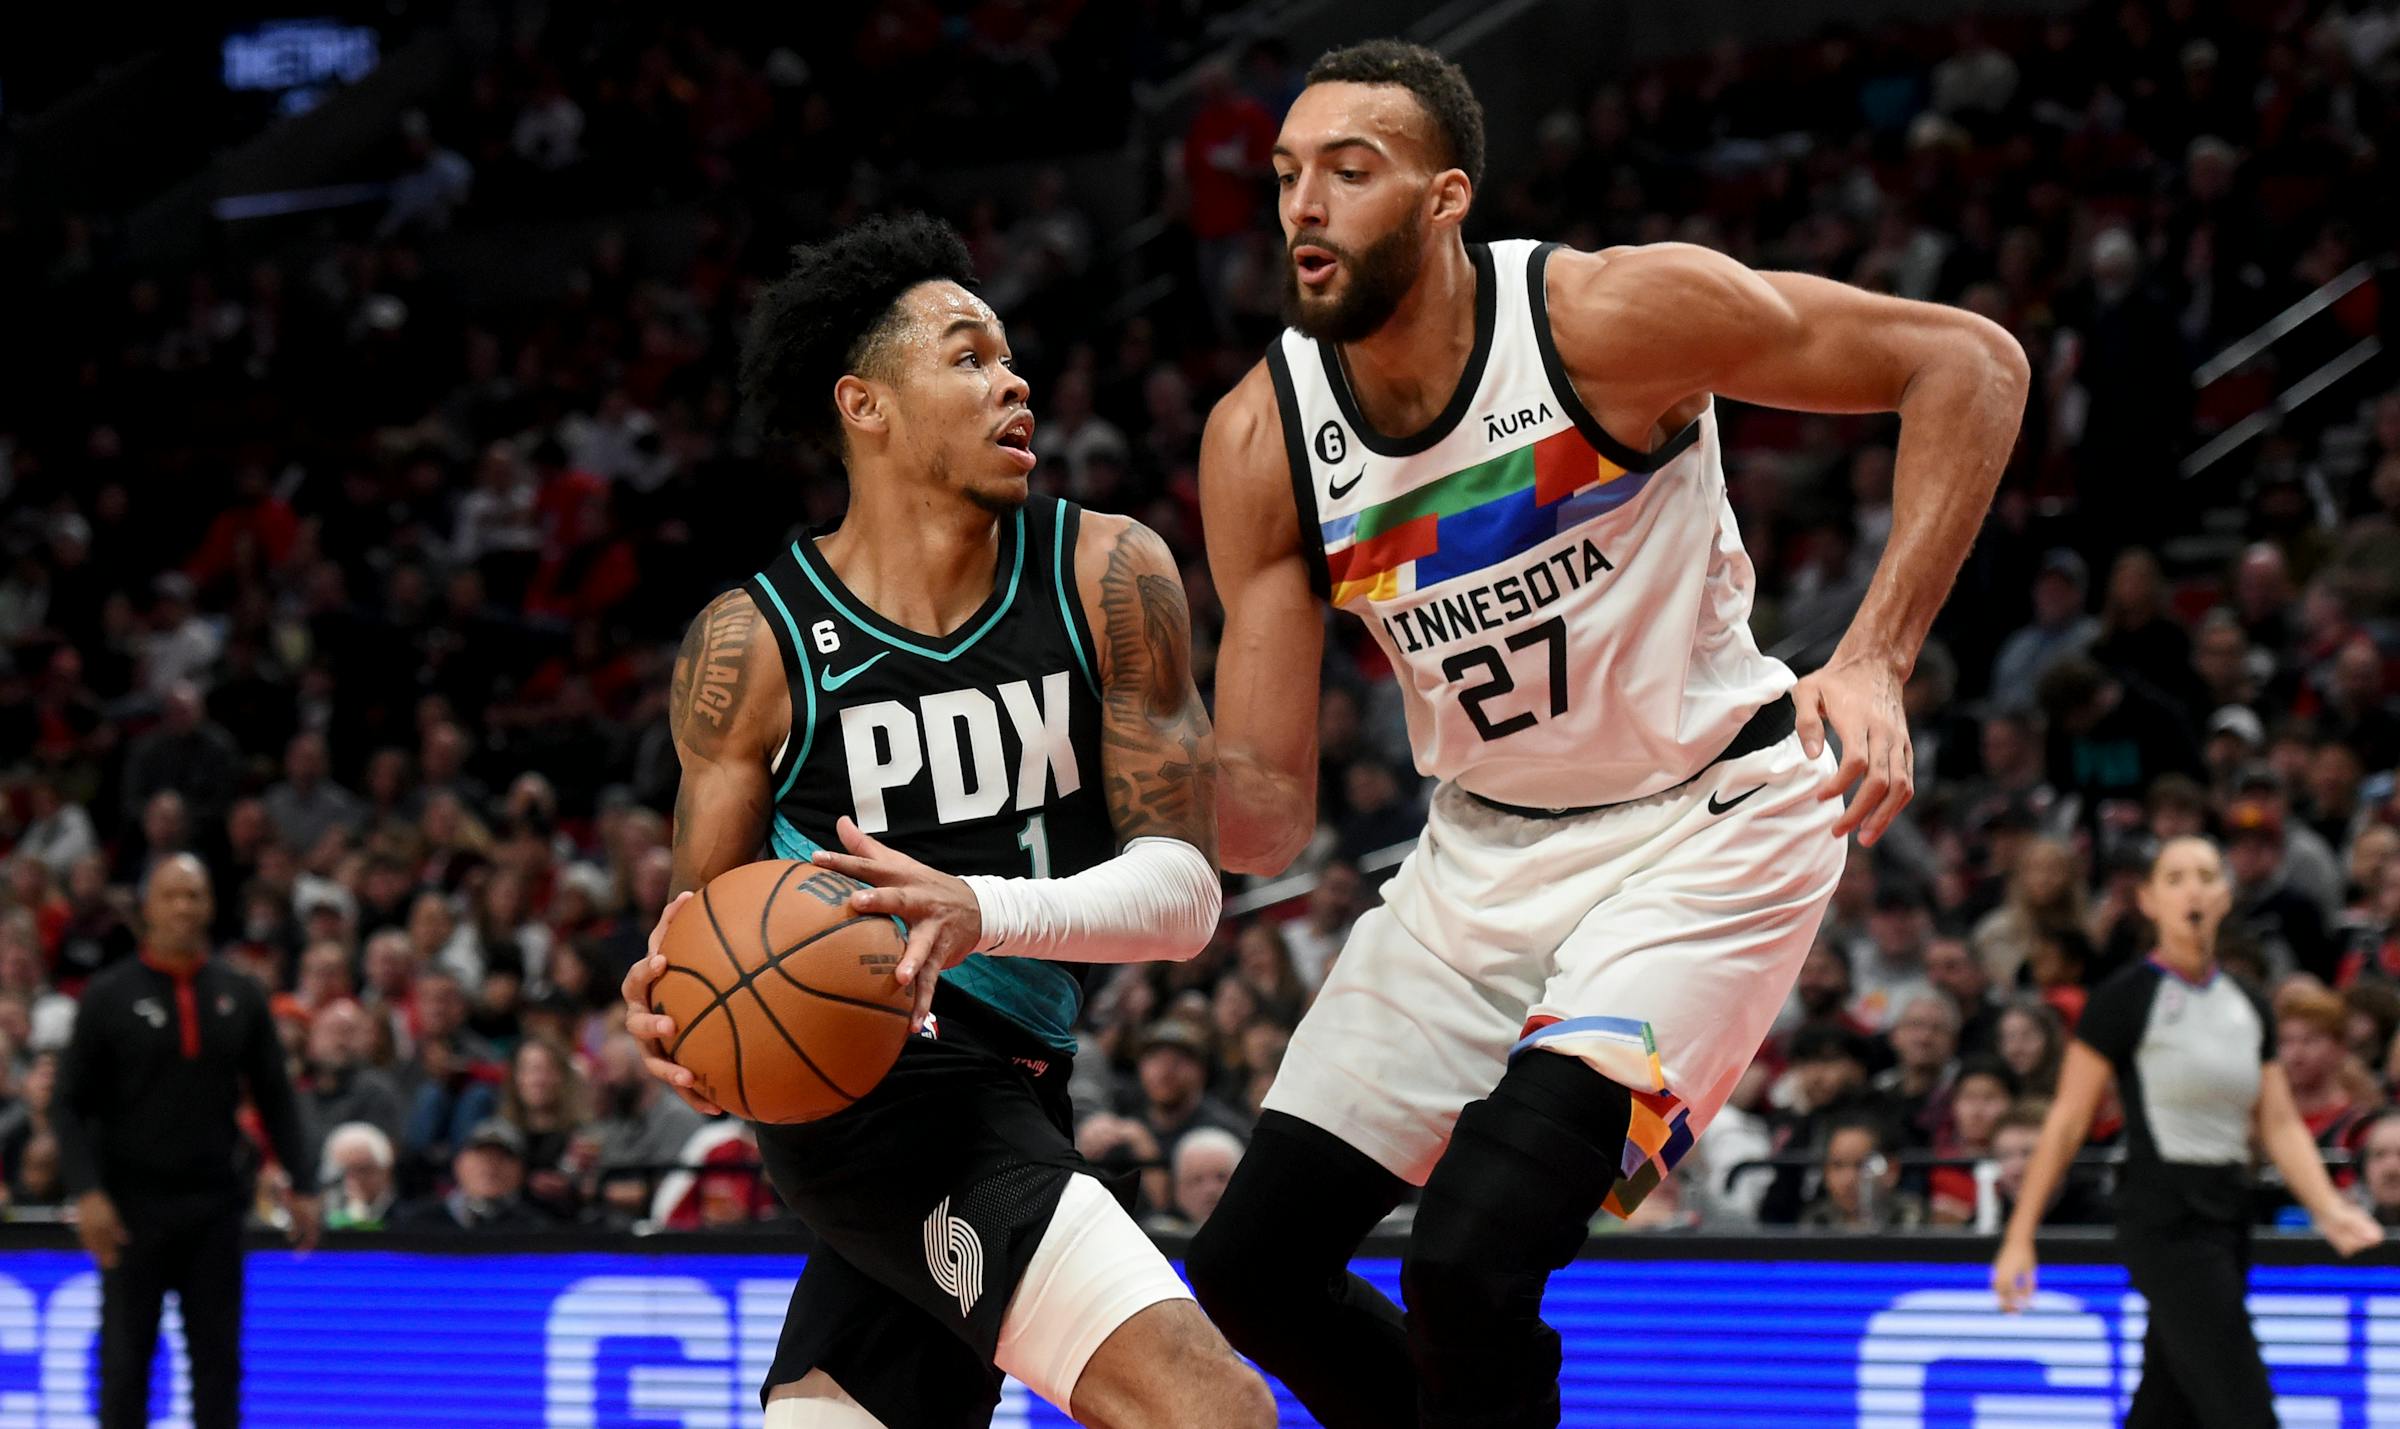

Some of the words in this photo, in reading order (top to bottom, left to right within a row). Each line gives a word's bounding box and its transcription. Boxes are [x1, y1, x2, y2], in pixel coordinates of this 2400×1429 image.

[1323, 426, 1343, 460] 6
[811, 619, 841, 654] 6
[1441, 615, 1568, 742] 27
[839, 670, 1081, 834] PDX
[1017, 812, 1051, 879] 1
